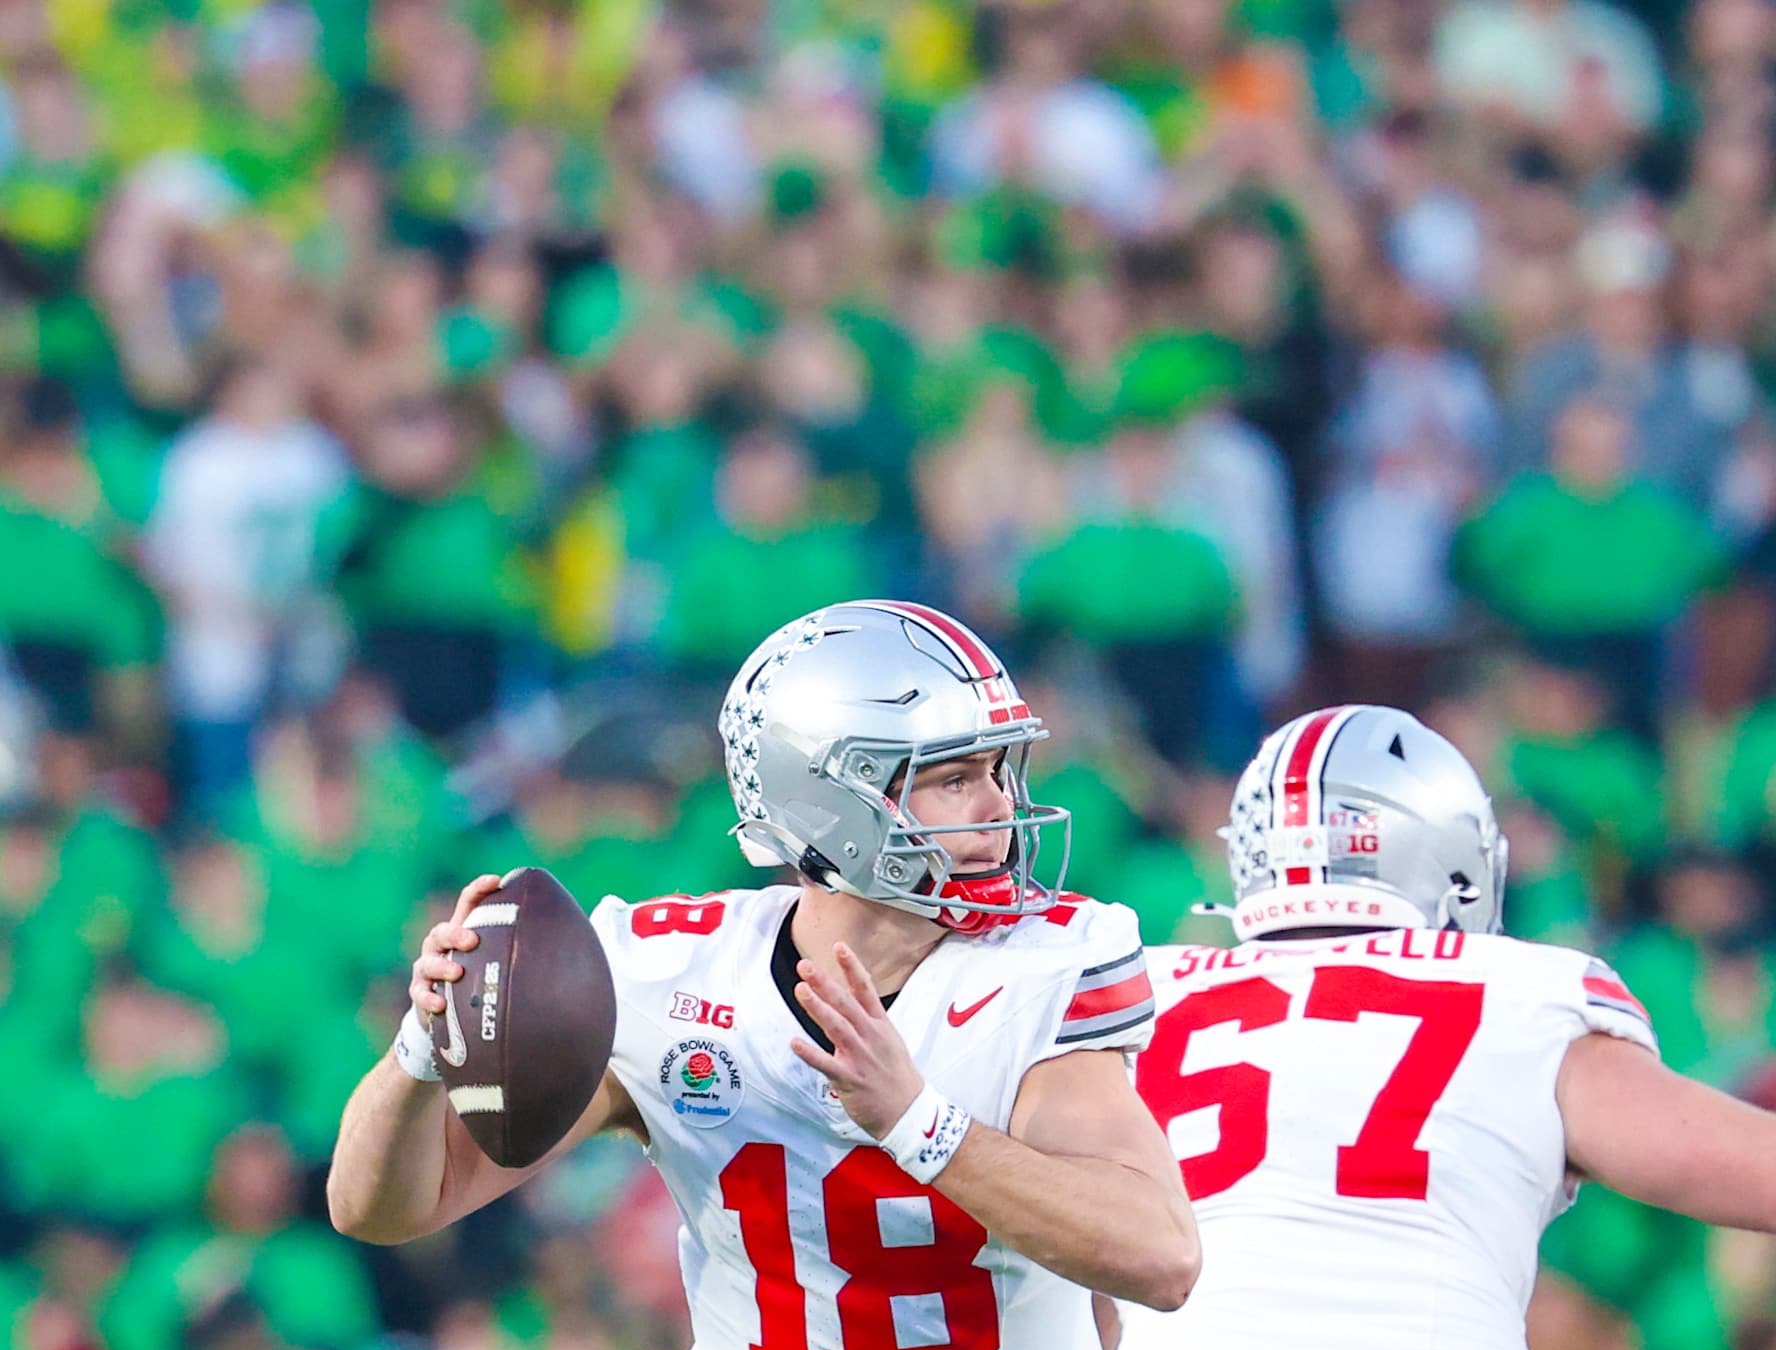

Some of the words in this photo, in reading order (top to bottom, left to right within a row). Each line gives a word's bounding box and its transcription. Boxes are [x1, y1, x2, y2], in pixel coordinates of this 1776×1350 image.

[1241, 900, 1382, 927] BUCKEYES
[660, 1048, 680, 1085] ROSE
[679, 1039, 718, 1056] BOWL
[718, 1050, 742, 1090] GAME
[1135, 964, 1485, 1201] 67
